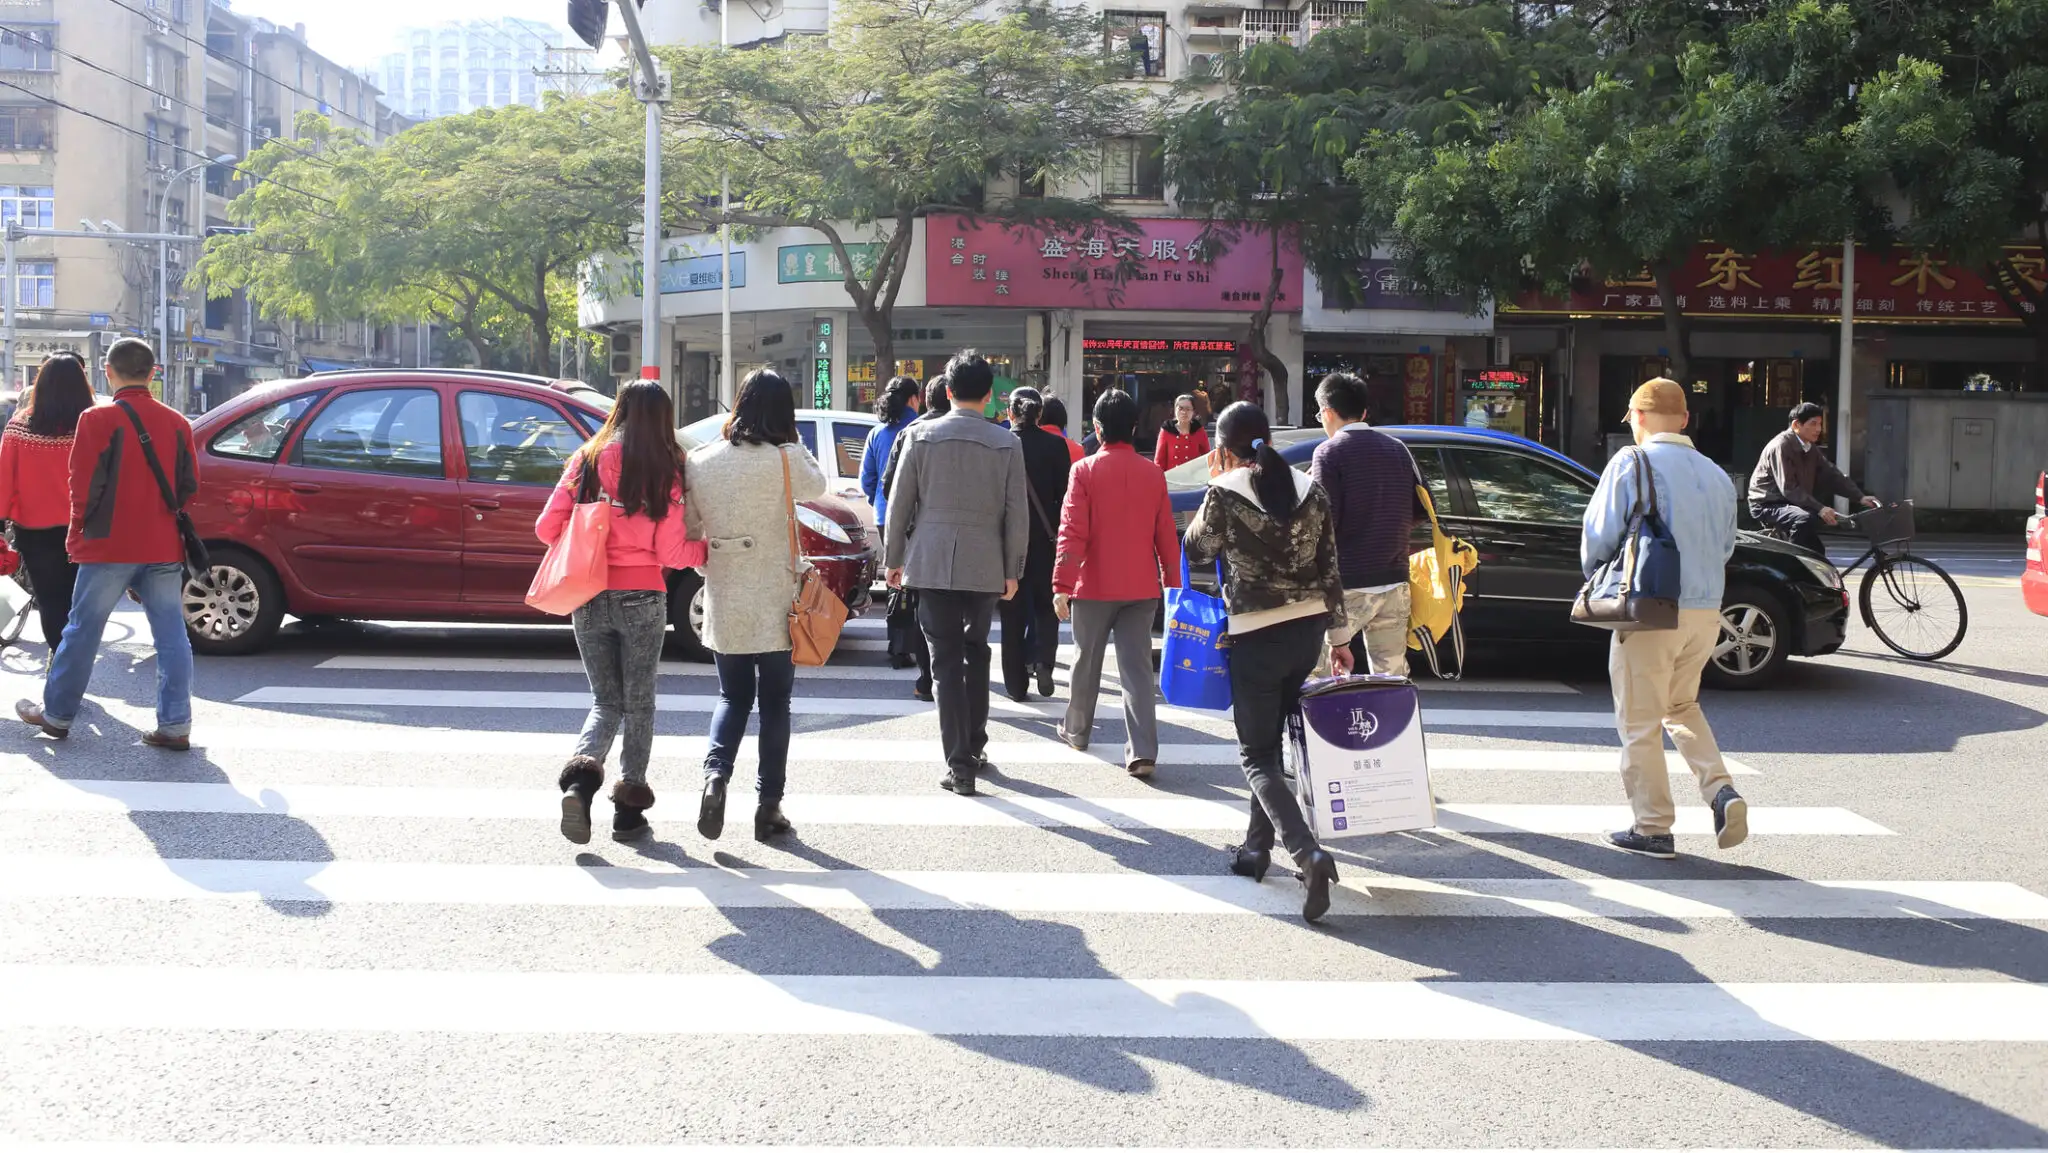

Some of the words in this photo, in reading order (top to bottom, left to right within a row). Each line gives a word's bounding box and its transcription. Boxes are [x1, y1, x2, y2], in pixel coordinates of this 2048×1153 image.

[1164, 270, 1182, 282] Fu
[1187, 270, 1210, 283] Shi
[1916, 300, 1998, 314] 传统工艺
